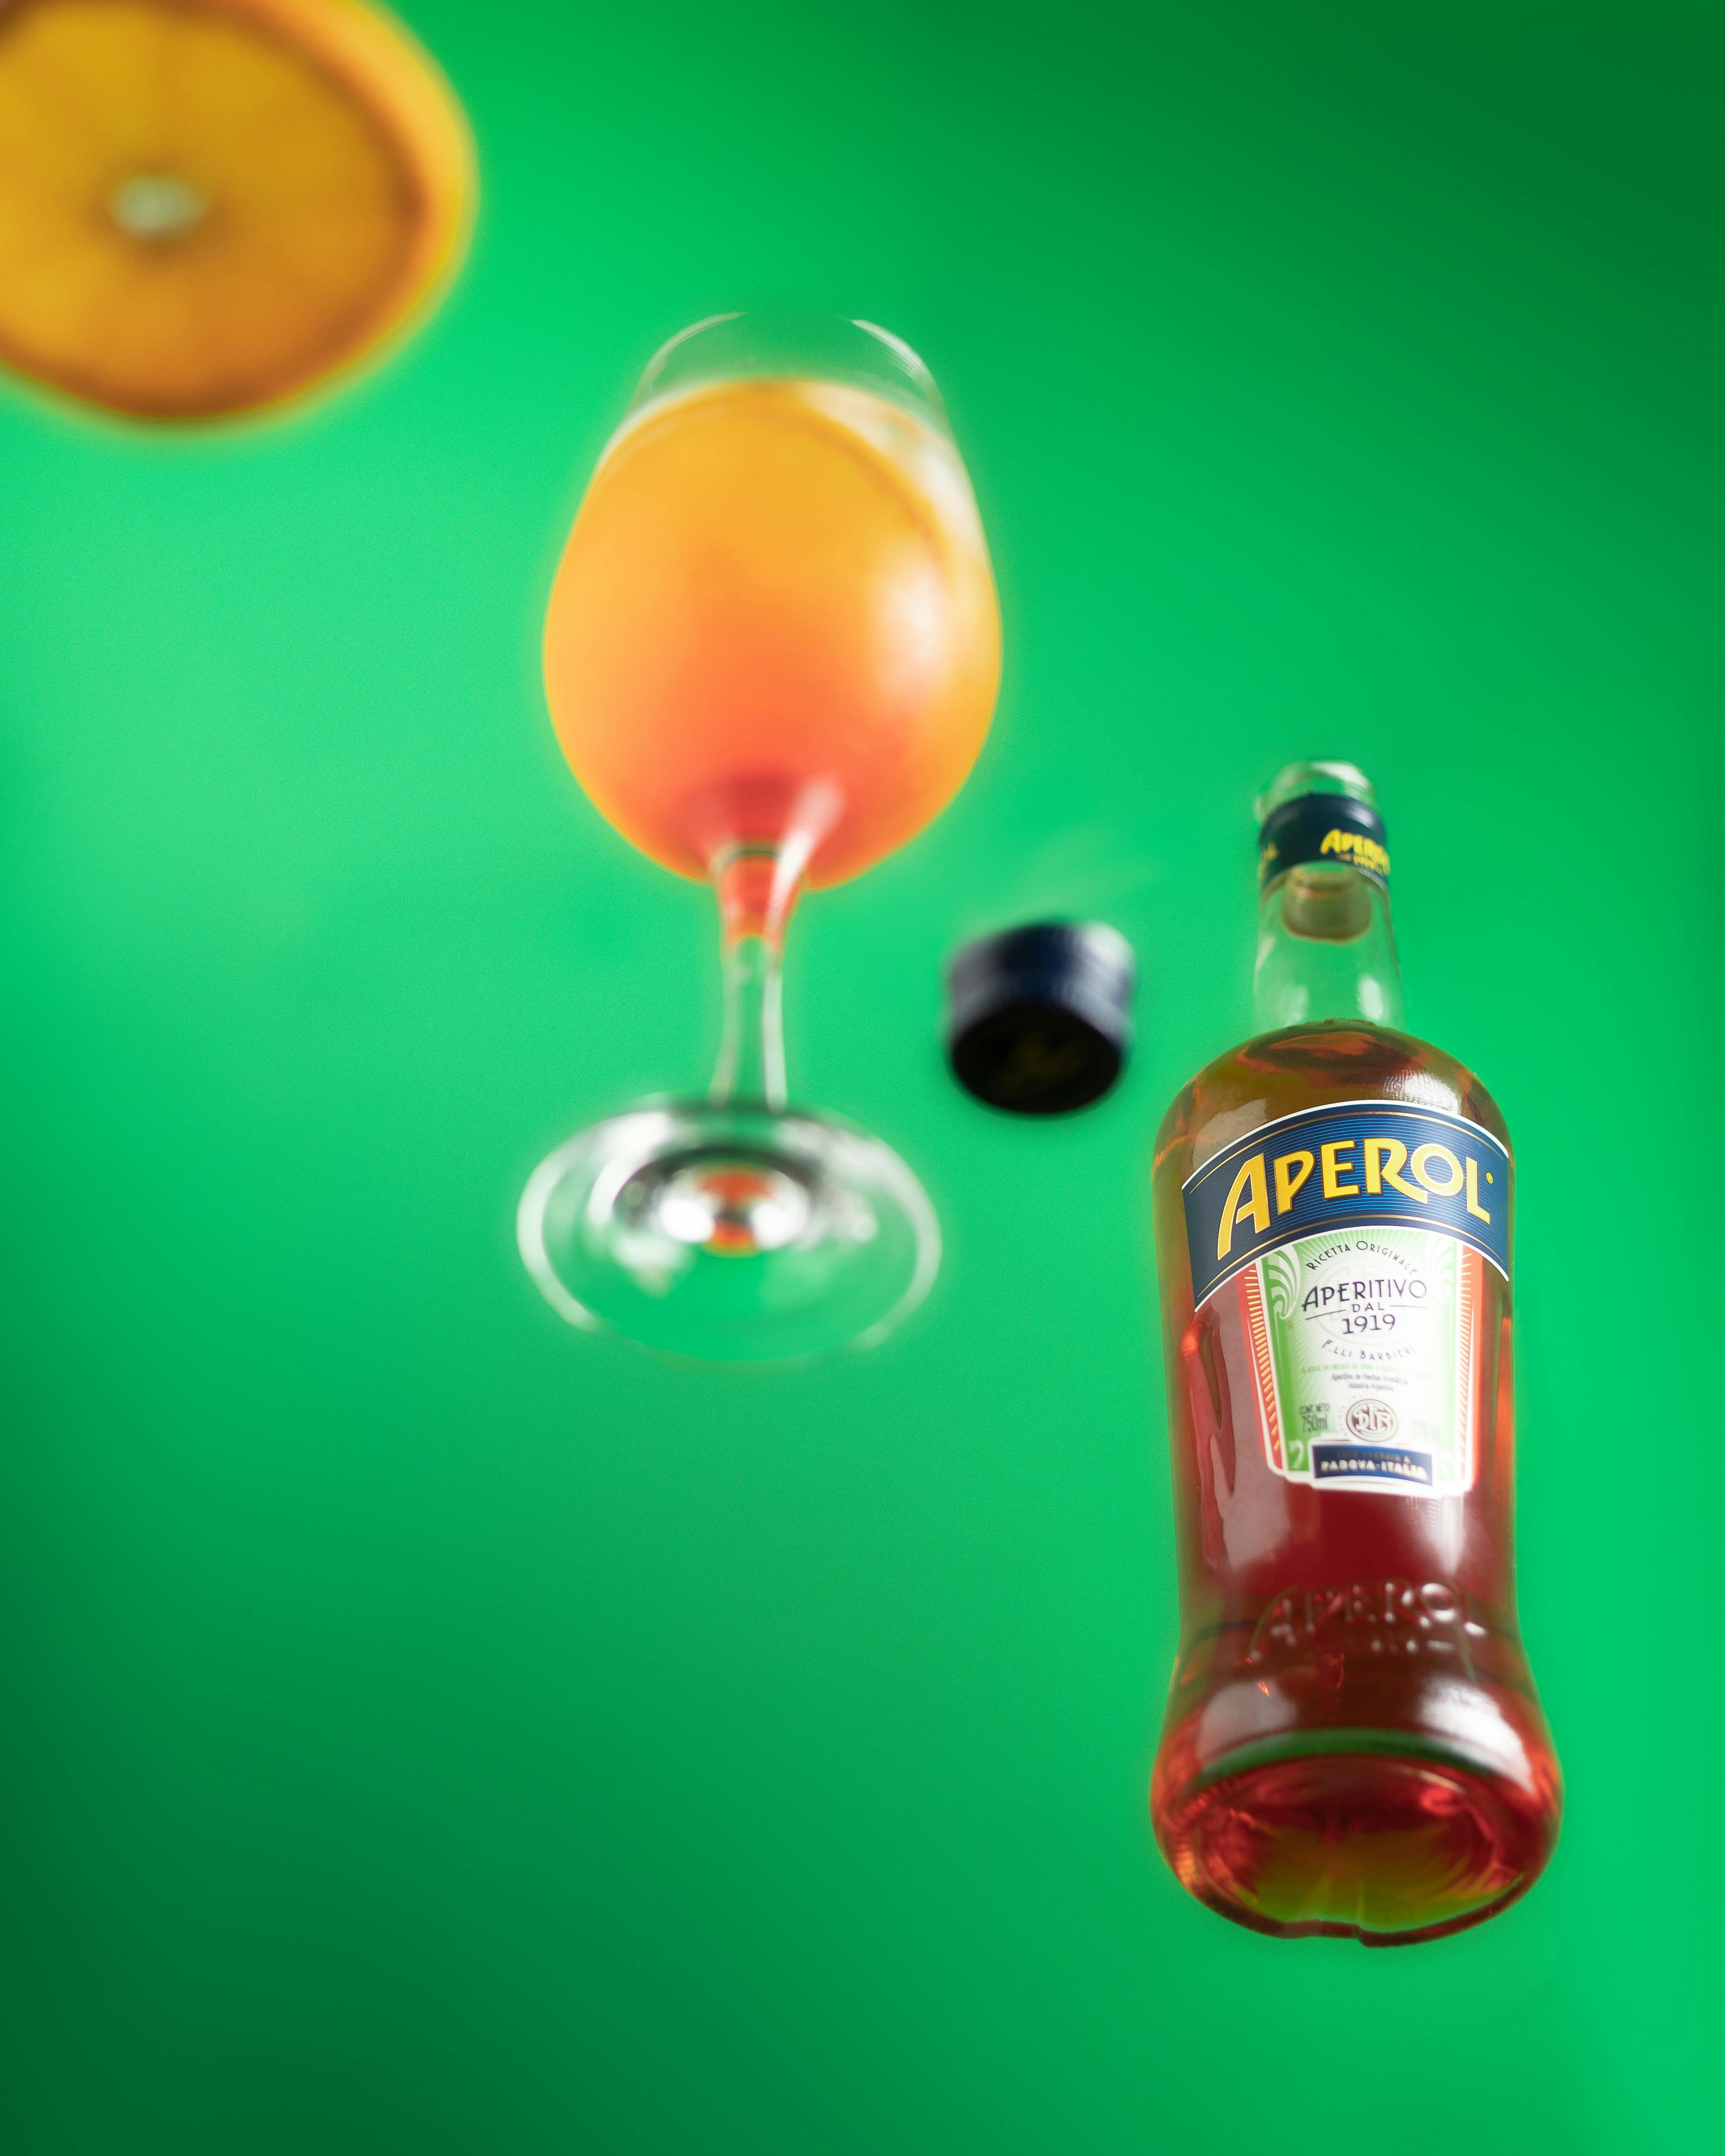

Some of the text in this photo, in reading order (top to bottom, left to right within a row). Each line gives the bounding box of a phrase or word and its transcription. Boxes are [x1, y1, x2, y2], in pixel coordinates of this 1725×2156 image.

[1218, 1138, 1490, 1261] APEROL
[1306, 1240, 1417, 1275] RICETTA ORIGINALE
[1300, 1279, 1427, 1312] APERITIVO
[1352, 1301, 1385, 1313] DAL
[1342, 1313, 1396, 1335] 1919
[1301, 1413, 1329, 1433] 750ml
